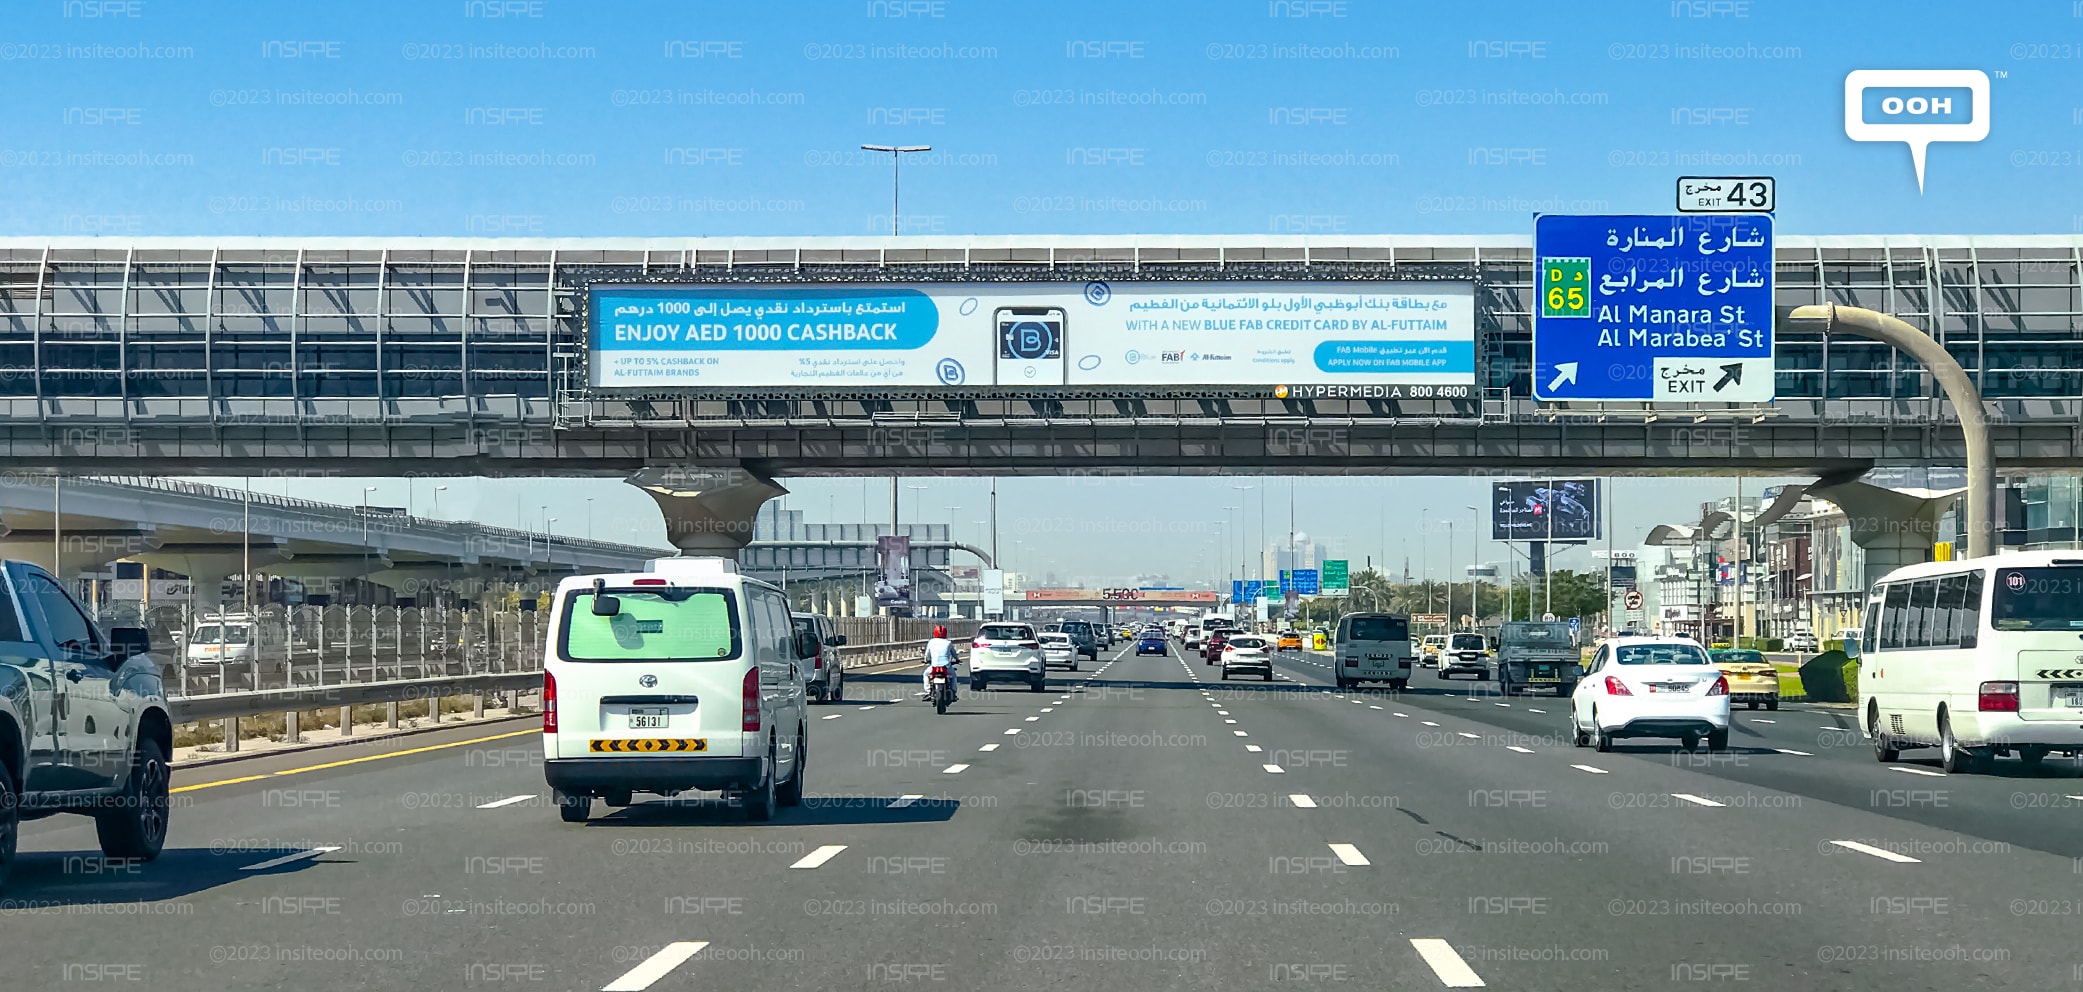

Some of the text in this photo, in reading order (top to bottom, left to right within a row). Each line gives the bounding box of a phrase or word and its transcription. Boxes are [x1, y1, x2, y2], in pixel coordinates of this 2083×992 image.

[1685, 183, 1722, 195] مخرج
[1727, 182, 1767, 207] 43
[1698, 197, 1721, 207] EXIT
[1606, 226, 1765, 255] شارع المنارة
[1551, 269, 1563, 282] D
[1574, 271, 1583, 281] د
[1598, 266, 1765, 295] شارع المرابع
[1129, 295, 1447, 314] مع بطاقة بنك أبوظبي الأول بلو الائتمانية من الفطيم
[1548, 288, 1584, 310] 65
[614, 301, 906, 318] استمتع باسترداد نقدي يصل إلى 1000 درهم
[1597, 305, 1745, 324] Al Manara St
[1126, 319, 1447, 330] WITH A NEW BLUE FAB CREDIT CARD BY AL-FUTTAIM
[615, 323, 897, 341] ENJOY AED 1000 CASHBACK
[1597, 329, 1764, 347] Al Marabea' St
[1336, 346, 1351, 354] FAB
[1353, 346, 1378, 354] Mobile
[620, 357, 632, 365] UP
[634, 357, 645, 365] TO
[646, 357, 659, 365] 5%
[661, 357, 705, 365] CASHBACK
[706, 357, 719, 365] ON
[1328, 358, 1447, 366] APPLY NOW ON FAB MOBILE APP
[614, 368, 700, 377] AL-FUTTAIM BRANDS
[1660, 365, 1706, 378] مخرج
[1292, 386, 1468, 397] HYPERMEDIA 800 4600
[1668, 381, 1706, 393] EXIT
[2007, 576, 2024, 586] 101
[636, 716, 661, 727] 56131
